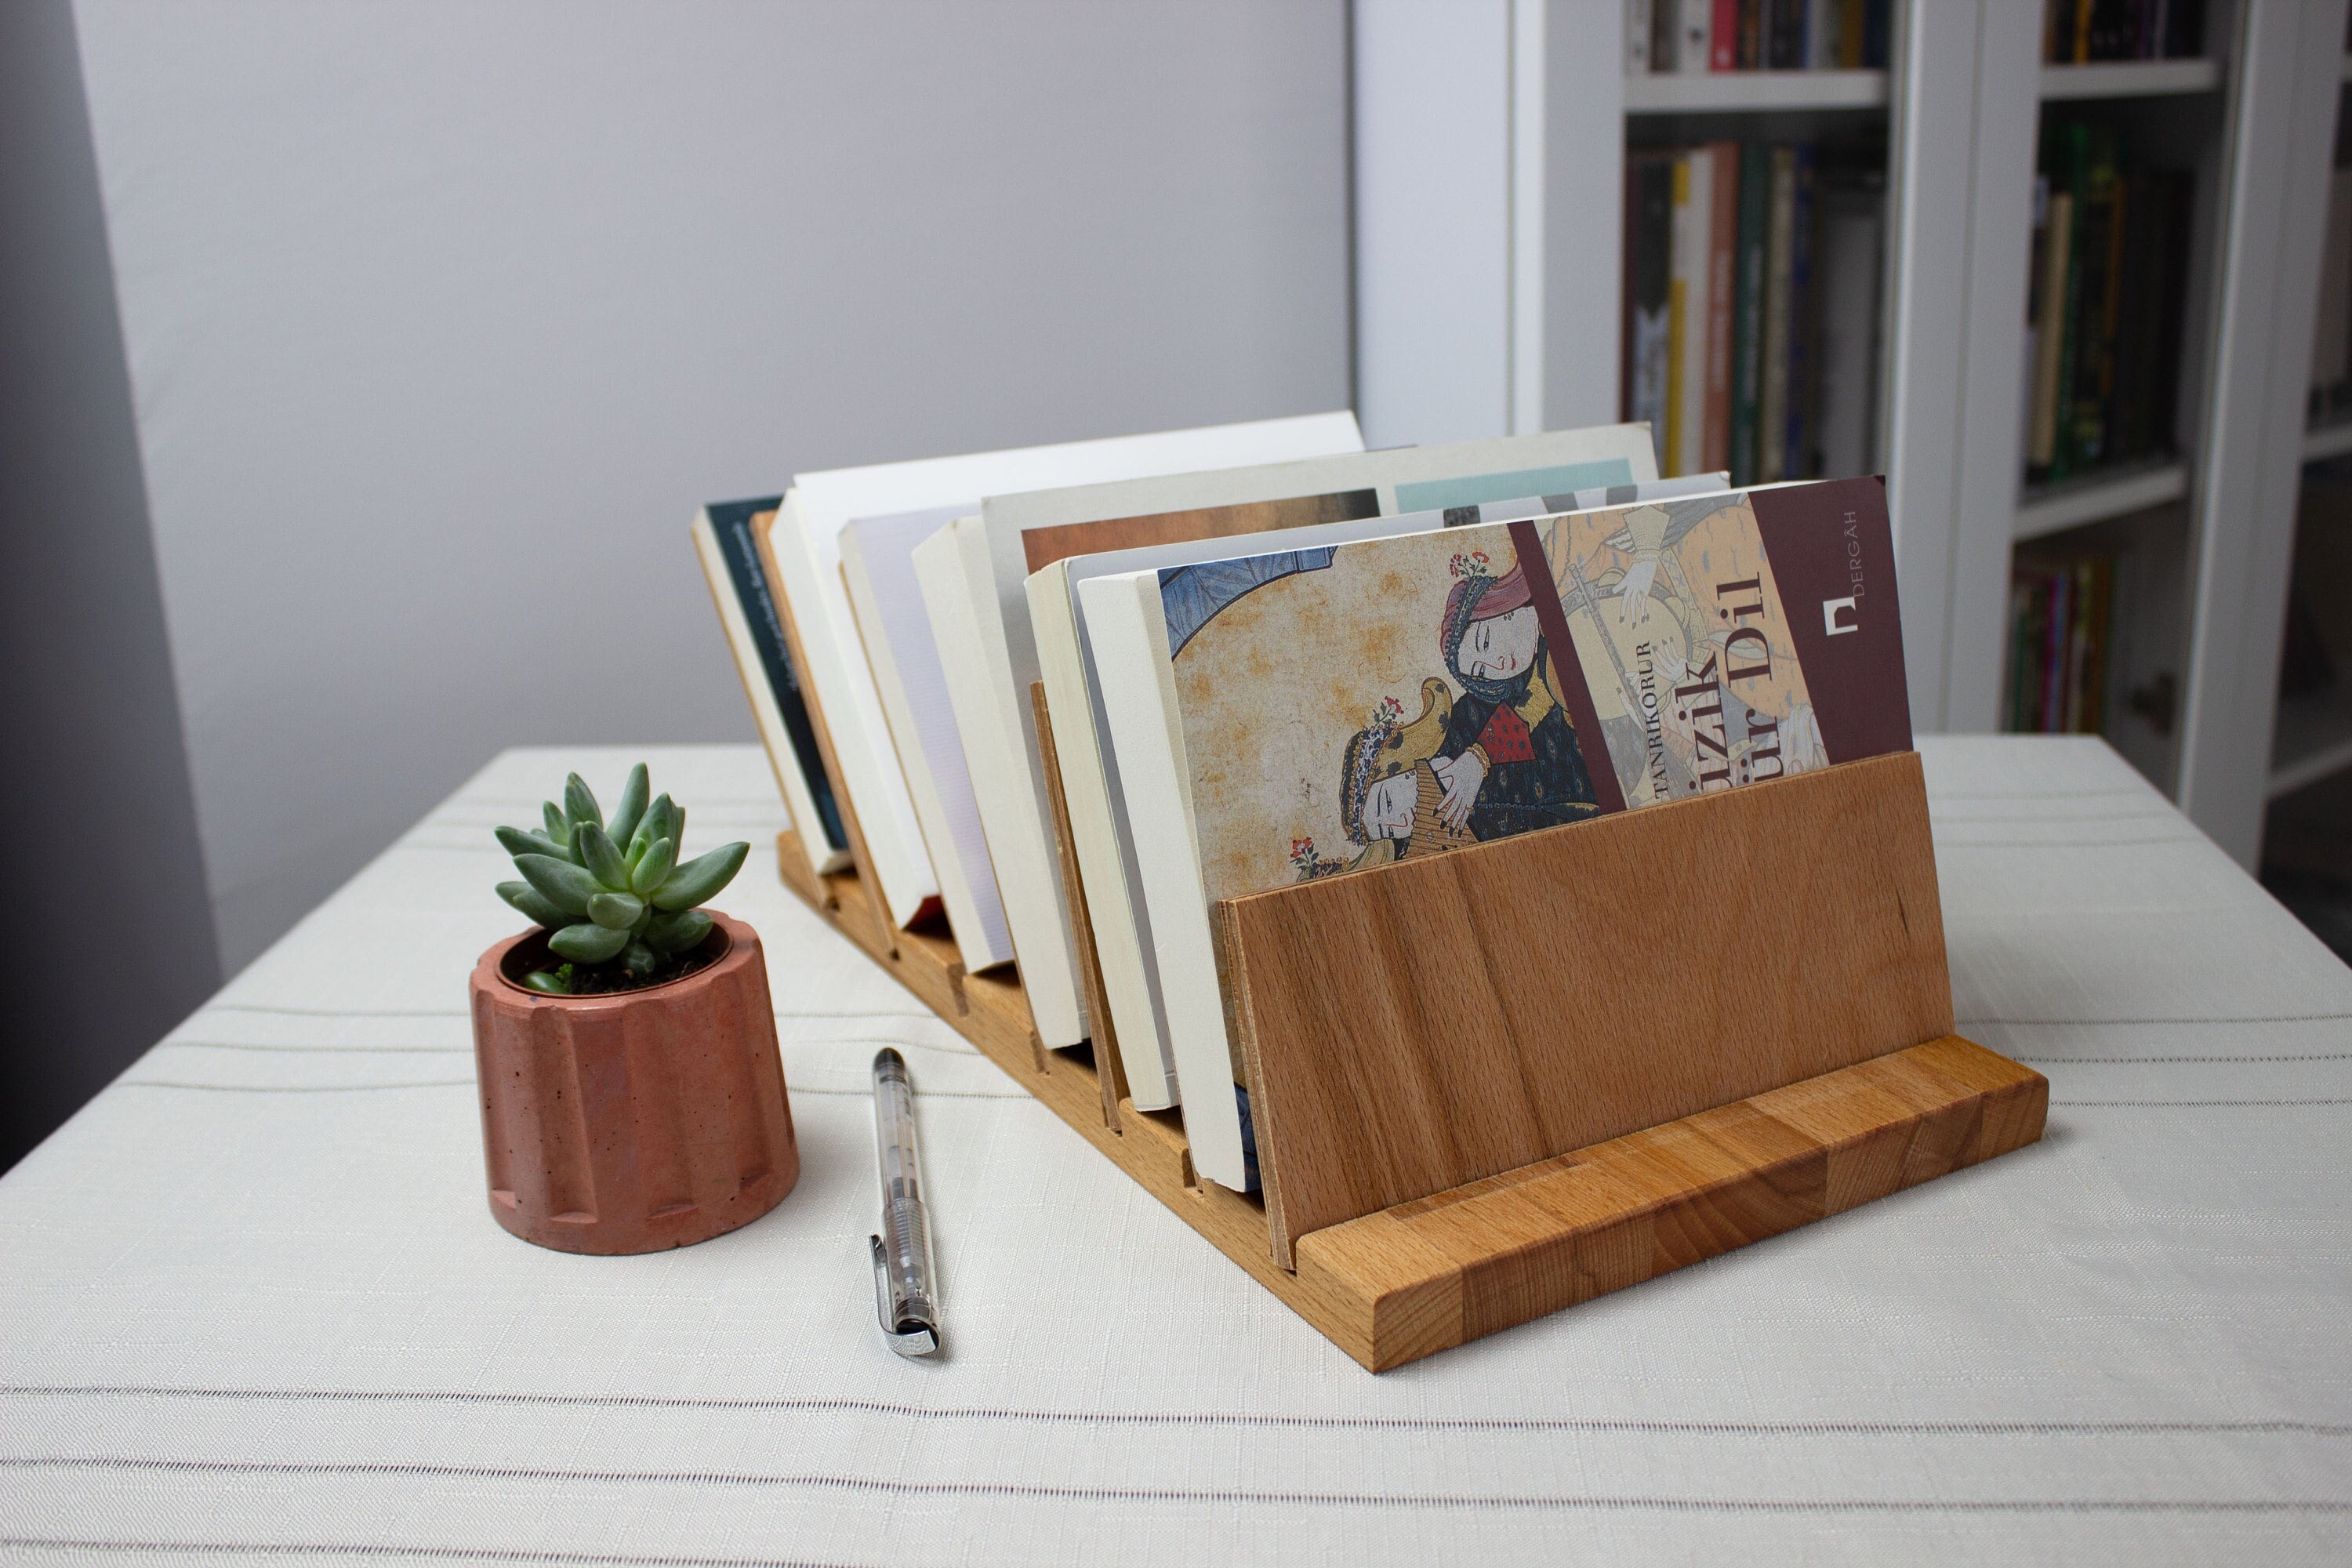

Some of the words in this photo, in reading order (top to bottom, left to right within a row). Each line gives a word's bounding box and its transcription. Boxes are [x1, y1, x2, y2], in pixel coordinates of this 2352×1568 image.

[1844, 511, 1864, 597] DERGÂH
[1716, 572, 1773, 688] Dil
[1635, 640, 1669, 800] TANRIKORUR
